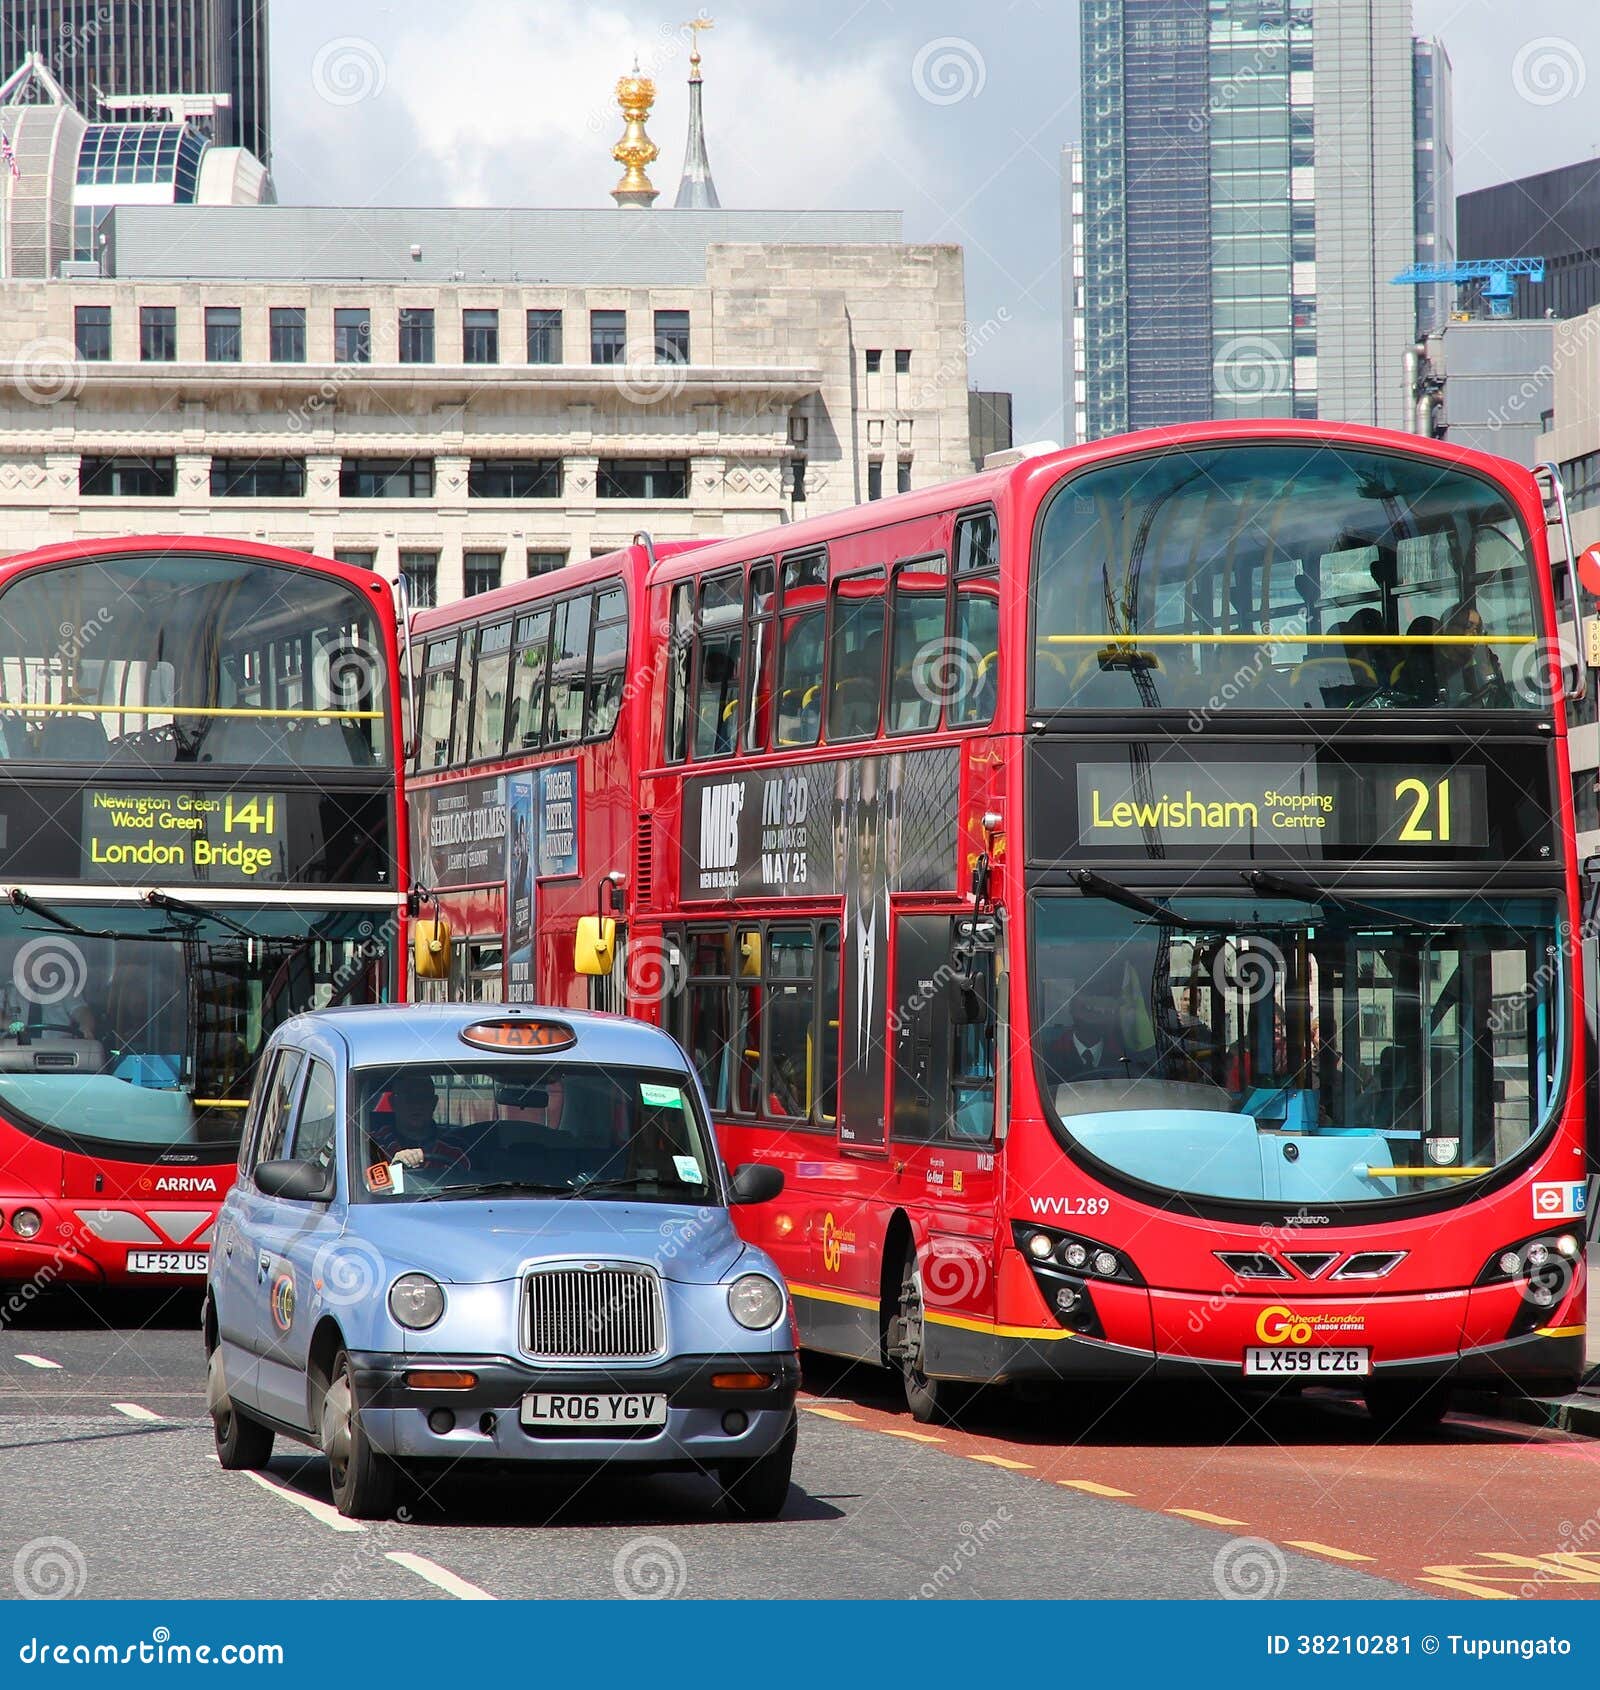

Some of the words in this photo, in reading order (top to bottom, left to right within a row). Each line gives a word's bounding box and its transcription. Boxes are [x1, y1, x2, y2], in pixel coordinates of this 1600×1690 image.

[545, 771, 572, 800] BIGGER
[93, 792, 171, 814] Newington
[177, 794, 220, 812] Green
[224, 795, 274, 834] 141
[762, 779, 783, 826] IN
[786, 776, 808, 825] 3D
[1092, 790, 1258, 828] Lewisham
[1395, 778, 1450, 841] 21
[1264, 791, 1333, 813] Shopping
[111, 812, 154, 829] Wood
[158, 812, 203, 830] Green
[430, 810, 473, 848] SHERLOCK
[473, 804, 506, 844] HOLMES
[546, 802, 573, 831] BETTER
[1271, 812, 1326, 828] Centre
[91, 837, 184, 865] London
[194, 839, 272, 875] Bridge
[762, 853, 790, 884] MAY
[793, 852, 807, 883] 25
[493, 1024, 556, 1046] TAXI
[155, 1177, 217, 1192] ARRIVA
[1030, 1197, 1111, 1215] WVL289
[135, 1254, 180, 1270] LF52
[185, 1255, 208, 1271] US
[1255, 1305, 1312, 1344] Go
[1288, 1313, 1365, 1324] Ahead-London
[1255, 1351, 1311, 1371] LX59
[1318, 1351, 1359, 1371] CZG
[532, 1395, 600, 1419] LR06
[608, 1395, 656, 1419] YGV
